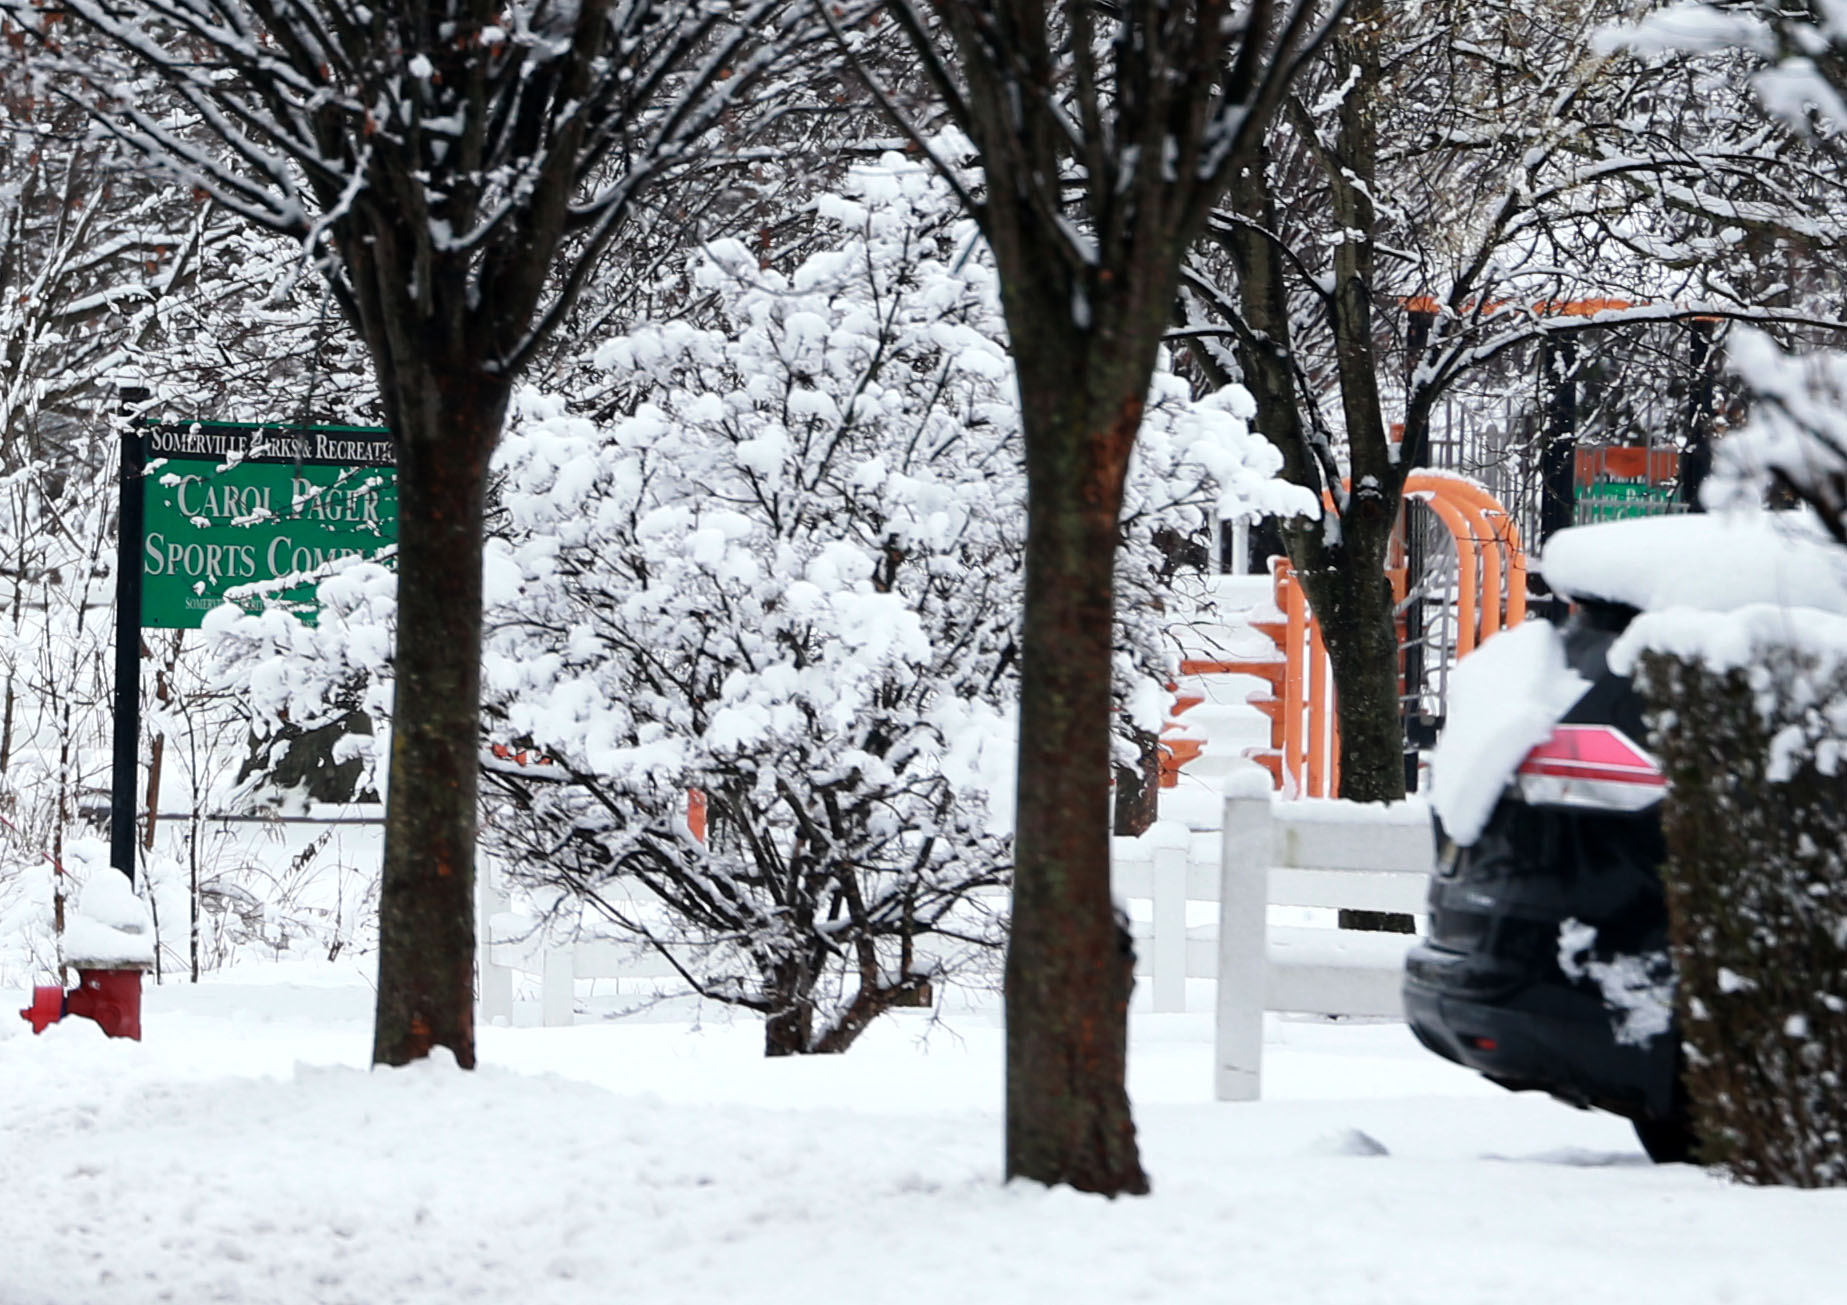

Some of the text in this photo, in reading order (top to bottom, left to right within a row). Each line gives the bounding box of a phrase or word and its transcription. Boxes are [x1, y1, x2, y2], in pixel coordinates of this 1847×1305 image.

[151, 426, 248, 456] SOMERVILLE
[301, 440, 312, 458] &
[143, 532, 256, 577] SPORTS
